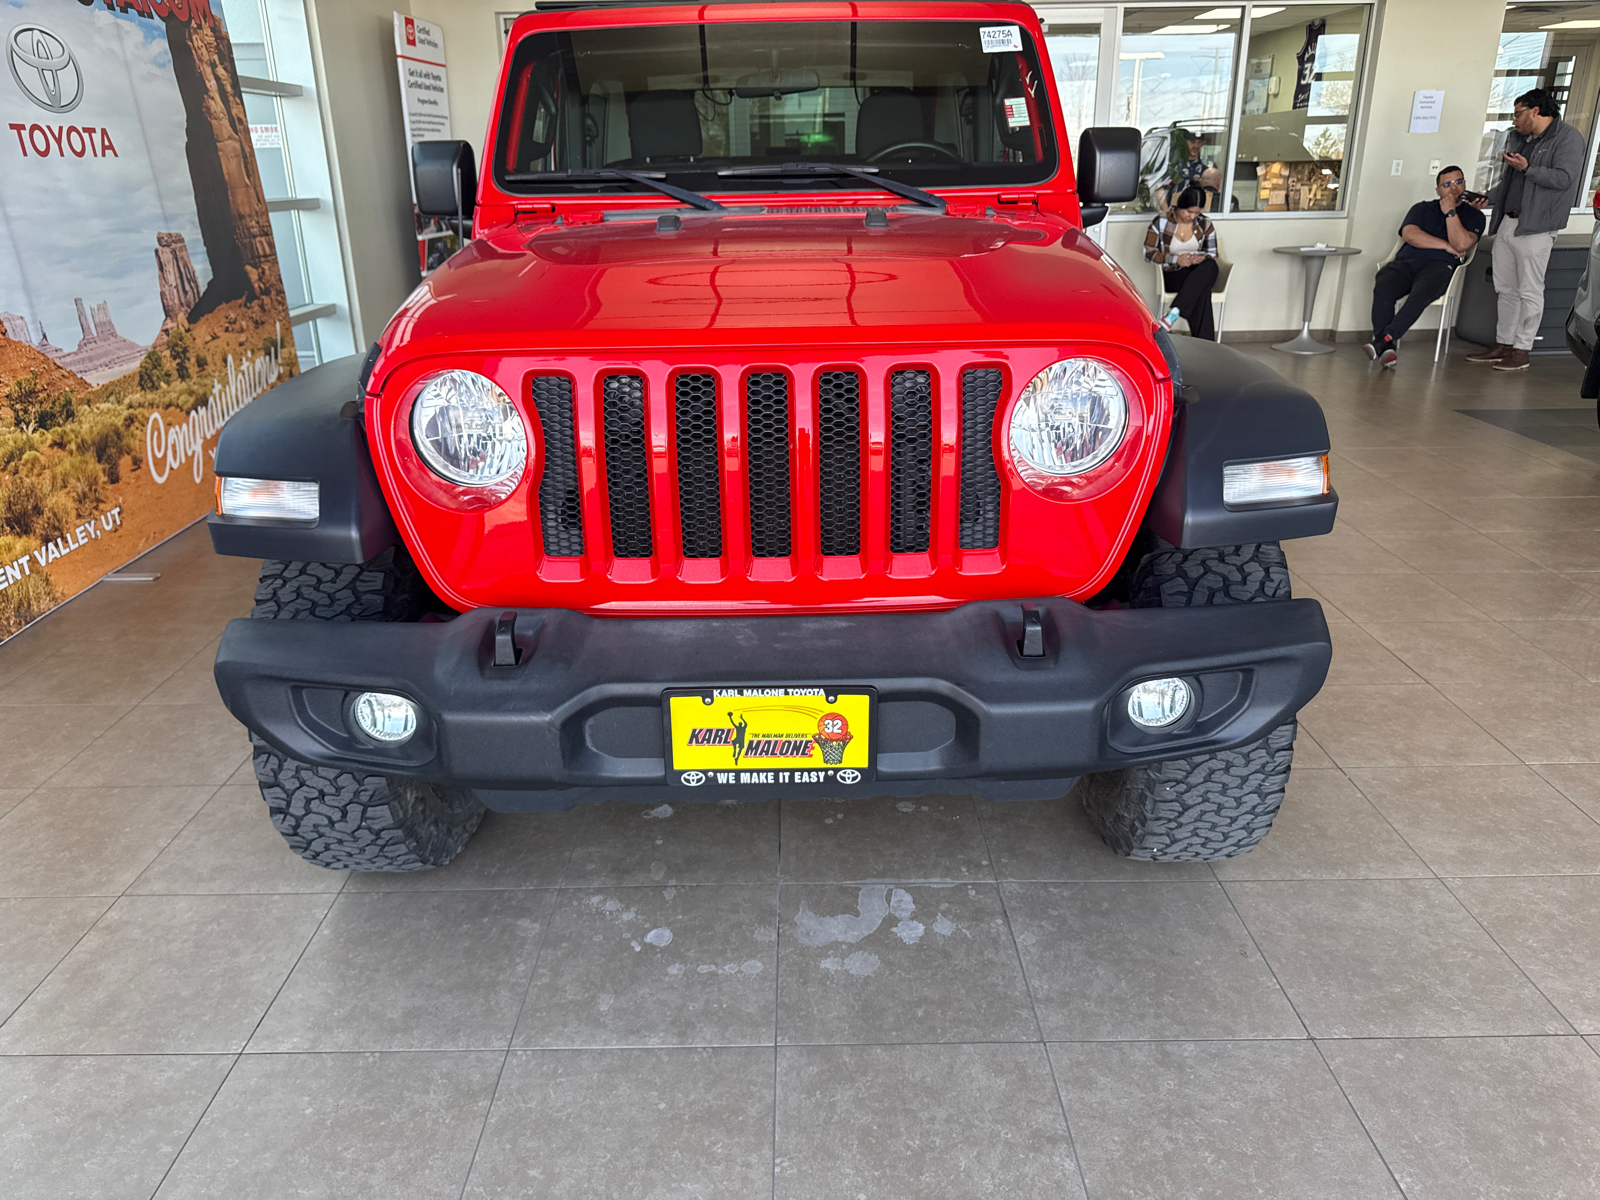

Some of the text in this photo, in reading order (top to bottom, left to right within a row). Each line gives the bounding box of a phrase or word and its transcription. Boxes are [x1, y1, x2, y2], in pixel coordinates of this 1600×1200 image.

[981, 29, 1013, 39] 74275A
[430, 72, 442, 83] Toyota
[1301, 62, 1319, 85] 32
[407, 79, 444, 93] Certified Used Vehicles
[8, 123, 119, 158] TOYOTA
[146, 320, 283, 484] Congratulations!
[0, 506, 121, 591] ENT VALLEY, UT
[713, 688, 826, 698] KARL MALONE TOYOTA
[824, 719, 843, 733] 32
[687, 728, 735, 746] KARL
[743, 739, 816, 758] MALONE
[716, 771, 826, 784] WE MAKE IT EASY
